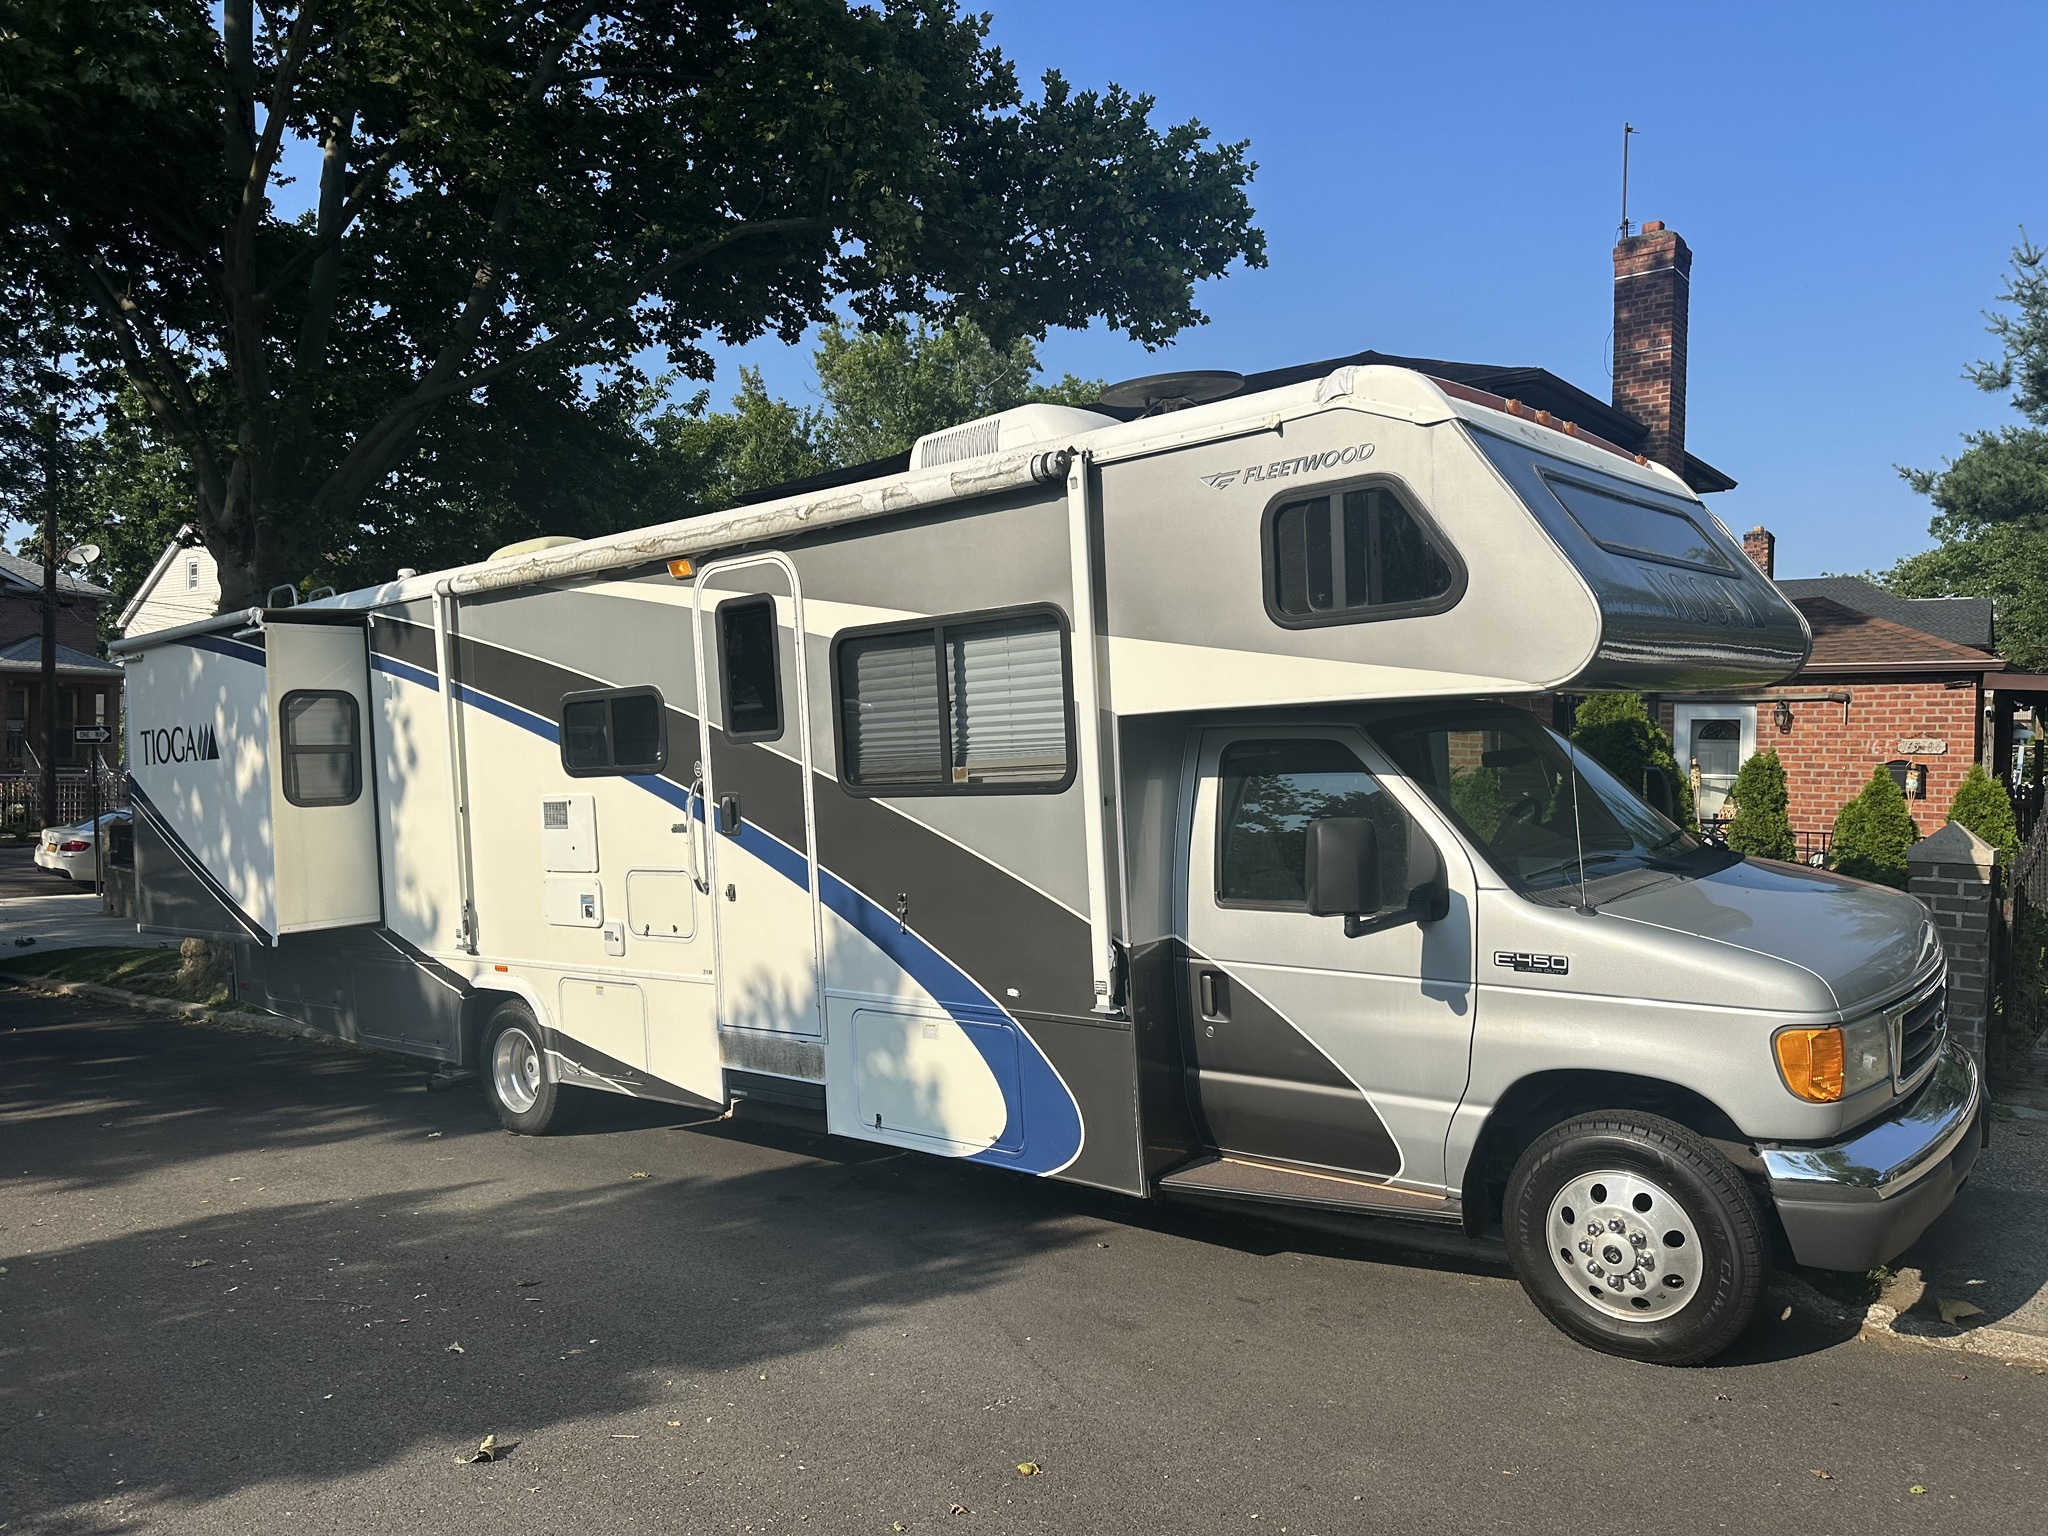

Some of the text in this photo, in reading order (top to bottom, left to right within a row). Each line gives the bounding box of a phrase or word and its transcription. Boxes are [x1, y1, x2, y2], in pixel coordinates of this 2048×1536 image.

[1242, 443, 1376, 485] FLEETWOOD
[80, 731, 106, 739] ONE WAY
[140, 724, 199, 765] TIOGA
